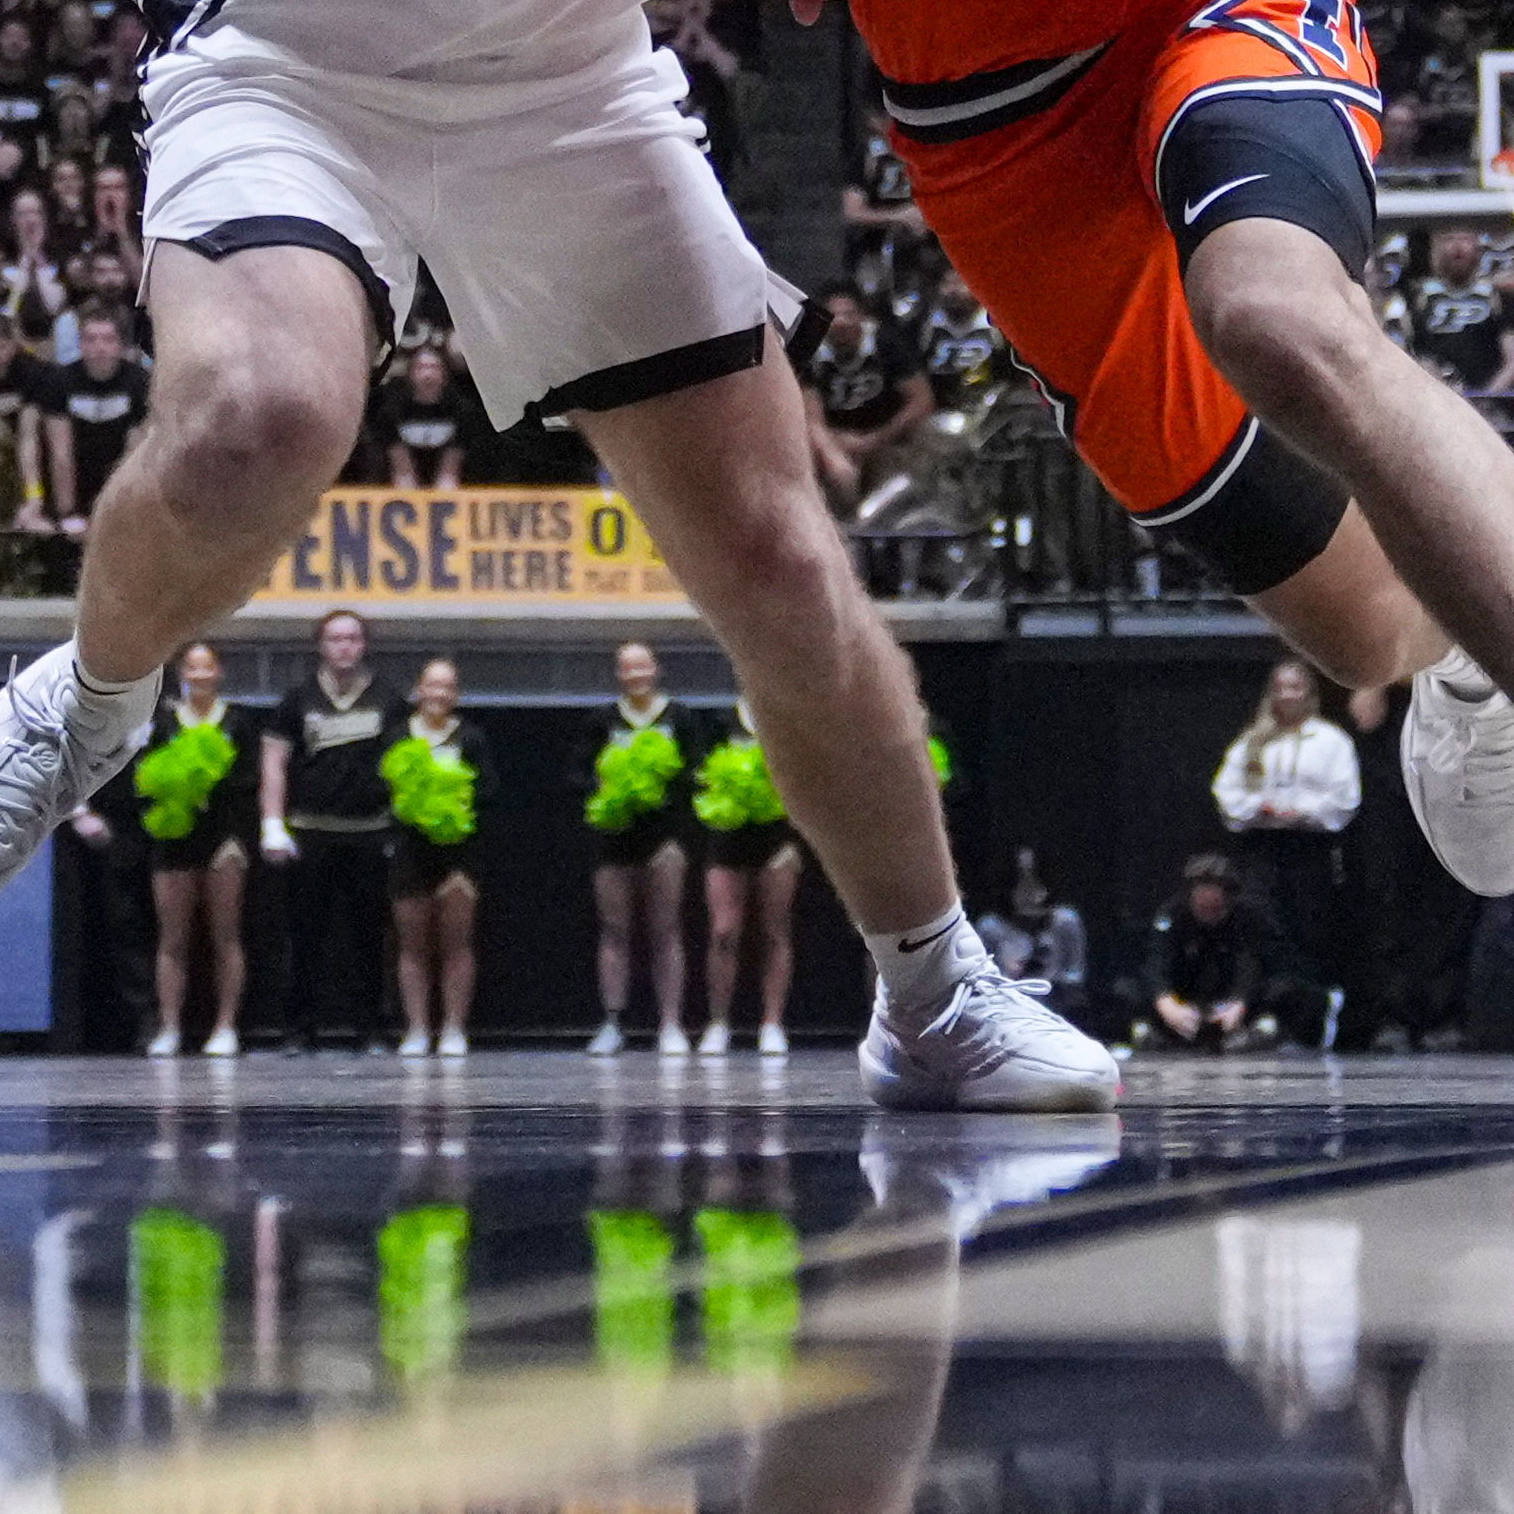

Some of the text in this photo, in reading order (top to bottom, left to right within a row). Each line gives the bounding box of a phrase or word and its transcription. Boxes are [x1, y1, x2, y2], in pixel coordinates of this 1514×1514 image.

[469, 500, 572, 540] LIVES
[294, 499, 461, 591] ENSE
[471, 549, 572, 591] HERE
